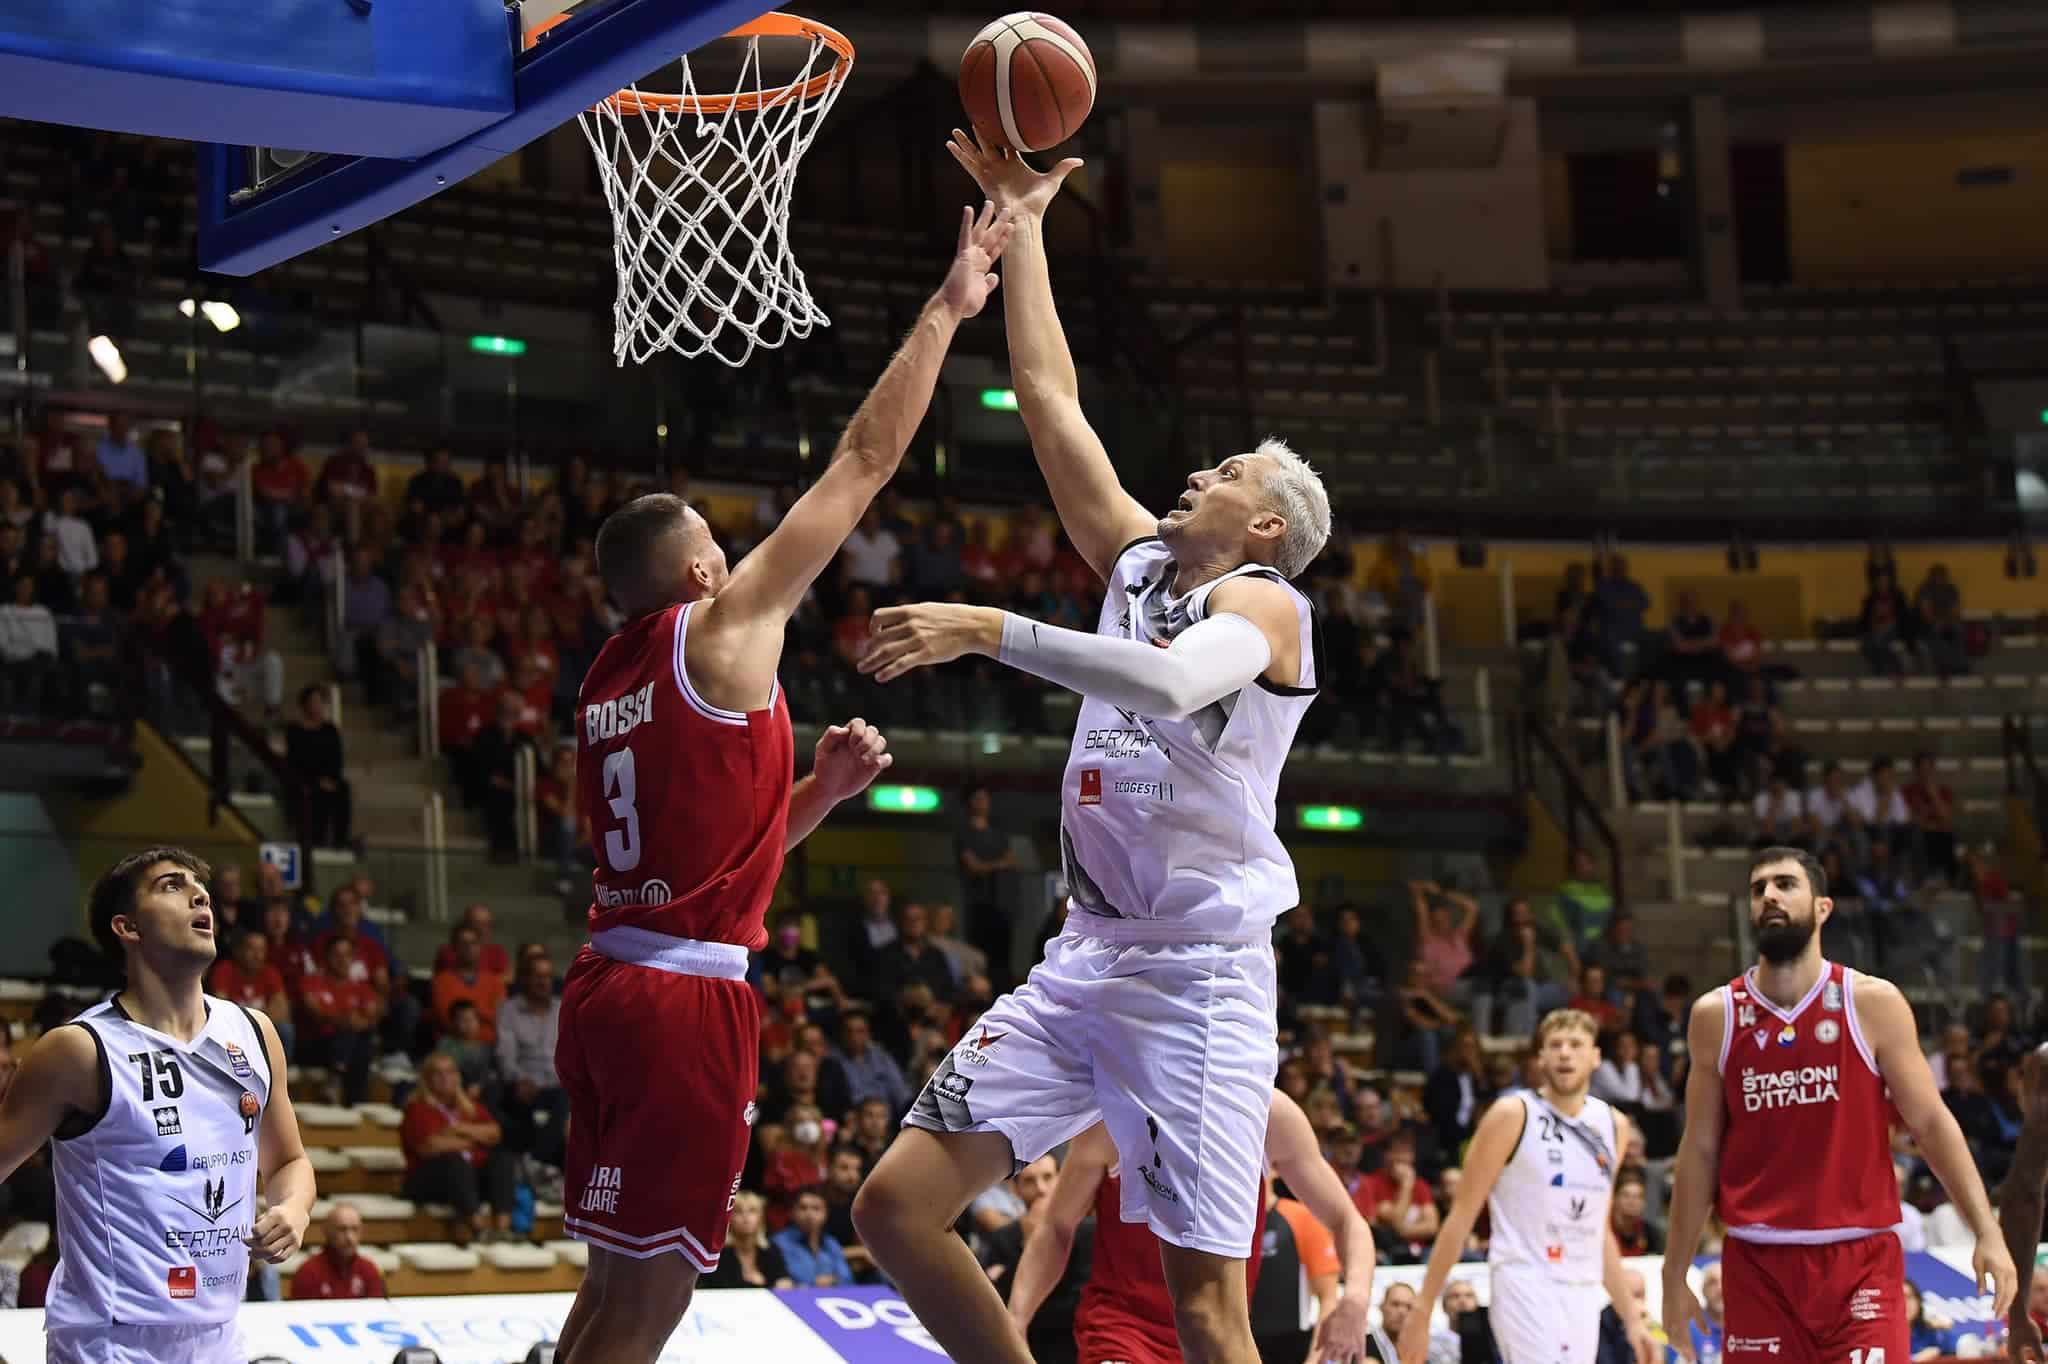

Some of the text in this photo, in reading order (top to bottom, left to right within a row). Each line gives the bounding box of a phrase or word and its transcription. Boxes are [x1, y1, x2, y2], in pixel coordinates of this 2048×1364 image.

[586, 681, 655, 745] BOSSI
[1084, 729, 1172, 760] BERTRA
[1104, 750, 1140, 759] YACHTS
[1114, 782, 1158, 795] ECOGEST
[603, 746, 641, 872] 3
[128, 1047, 184, 1101] 75
[1742, 1065, 1838, 1093] STAGIONI
[1744, 1083, 1840, 1112] D'ITALIA
[1539, 1115, 1564, 1143] 24
[192, 1153, 228, 1169] GRUPPO
[189, 1247, 227, 1258] YACHTS
